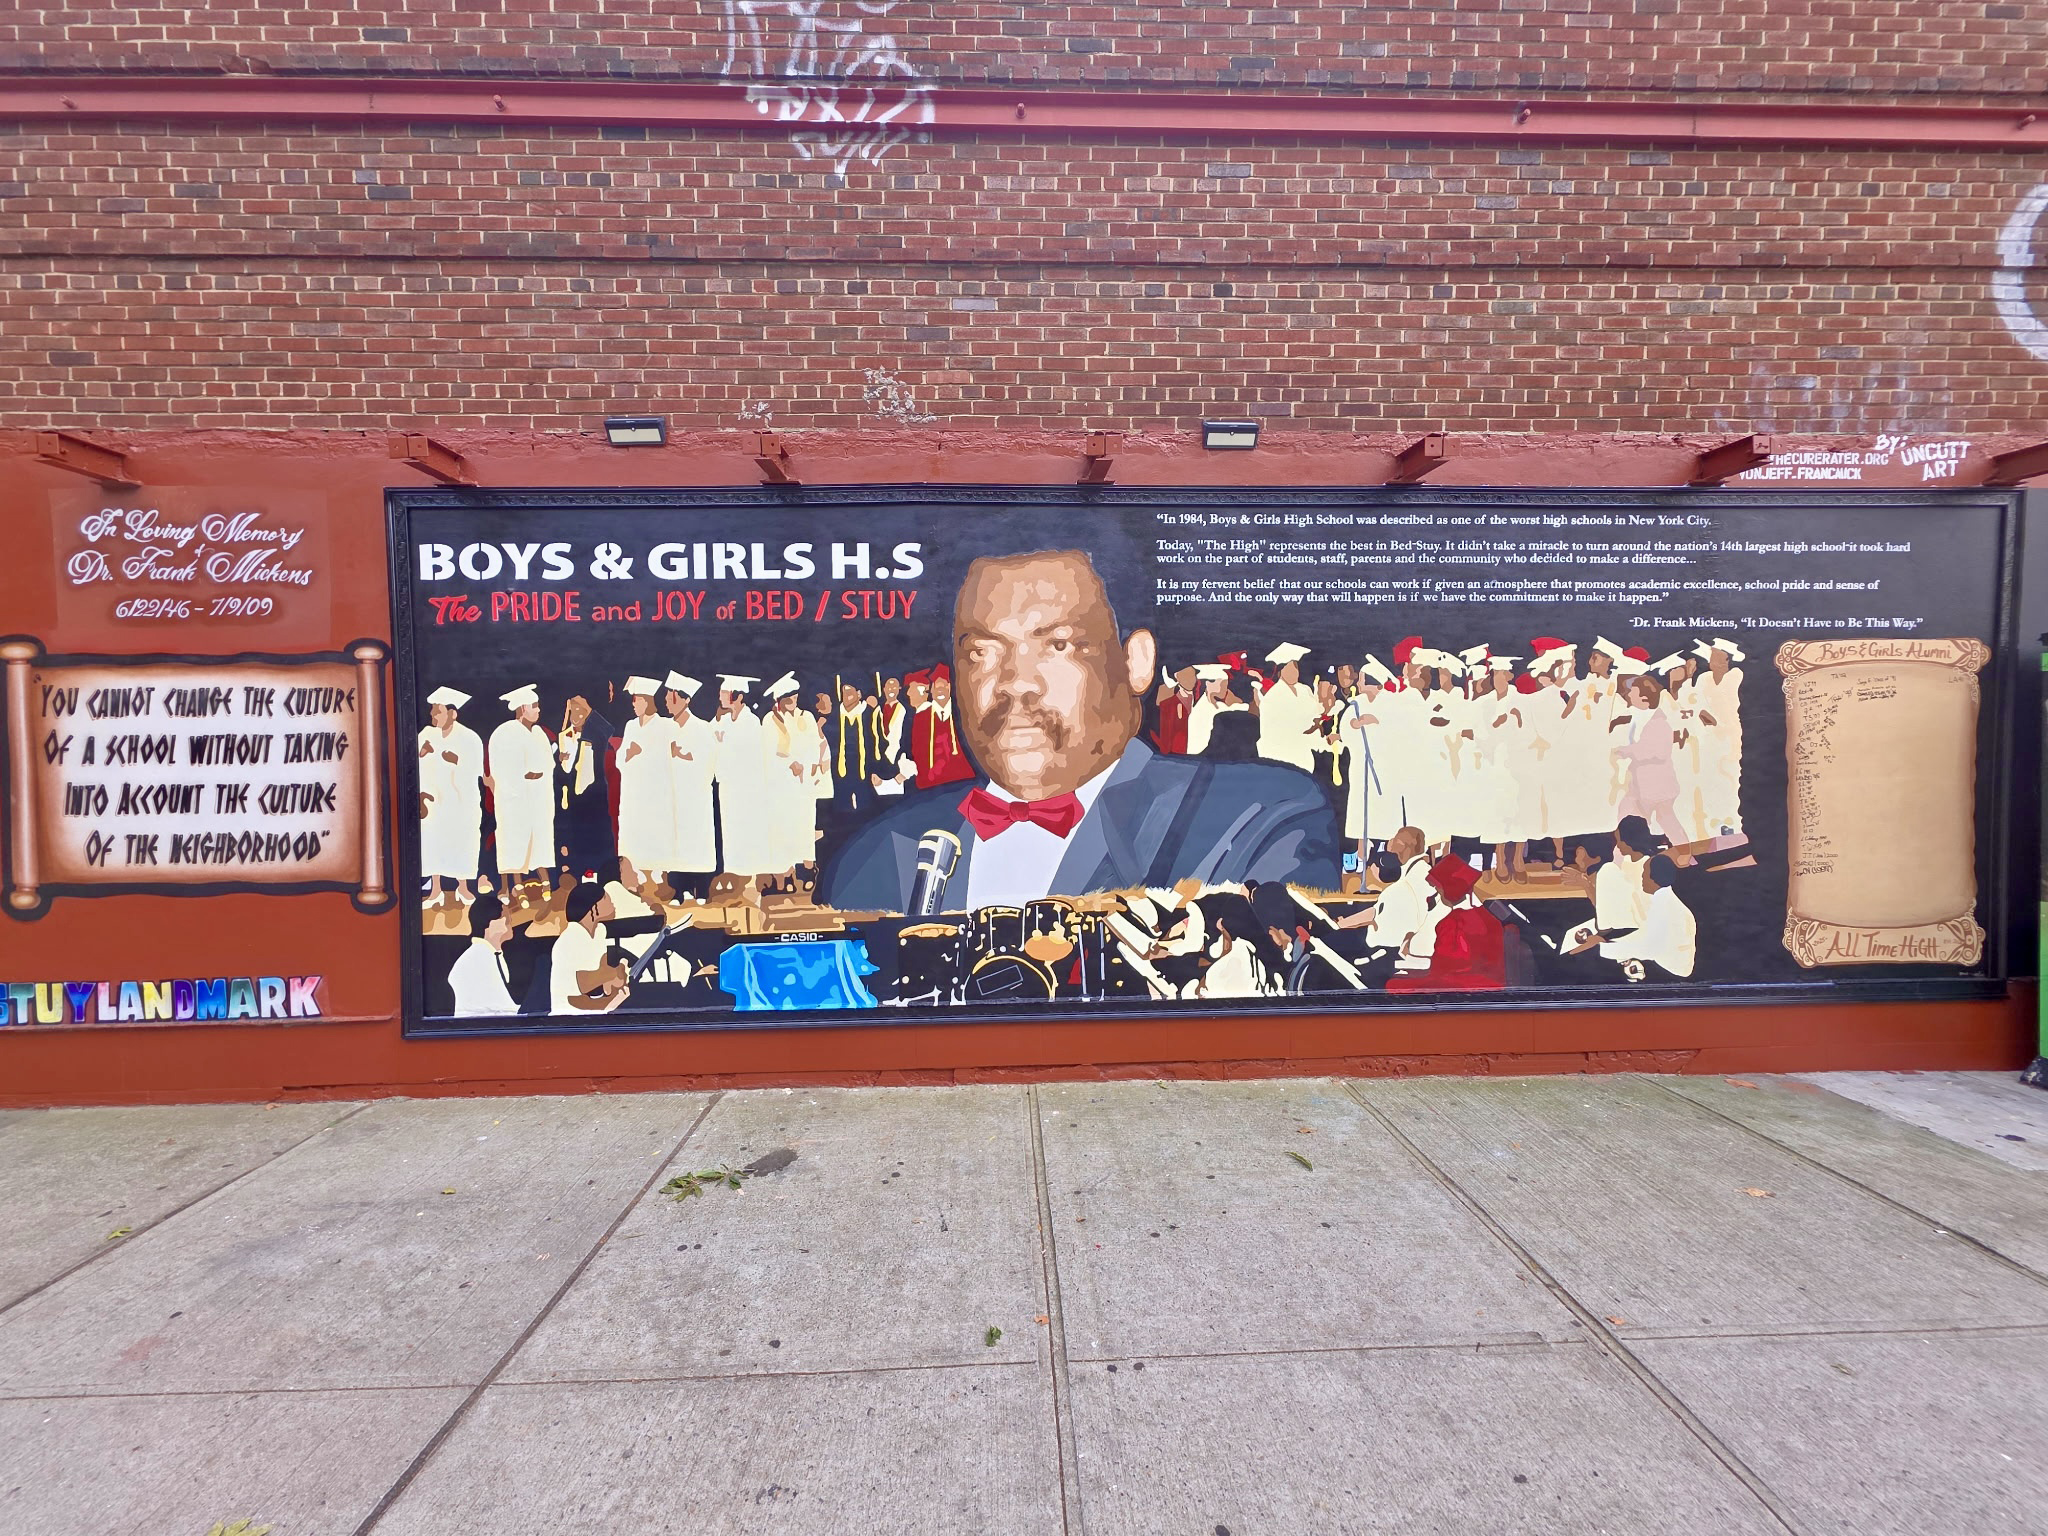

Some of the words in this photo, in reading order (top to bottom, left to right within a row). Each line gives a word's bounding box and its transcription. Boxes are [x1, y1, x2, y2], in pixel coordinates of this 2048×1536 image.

[1901, 441, 1971, 466] UNCUTT
[1922, 459, 1959, 481] ART
[80, 509, 123, 542] In
[124, 509, 198, 548] Loving
[202, 513, 304, 550] Memory
[1178, 513, 1207, 527] 1984,
[1209, 513, 1238, 528] Boys
[1239, 514, 1251, 525] &
[1253, 513, 1282, 525] Girls
[1283, 513, 1314, 528] High
[1316, 513, 1354, 525] School
[1355, 516, 1378, 525] was
[1379, 513, 1434, 525] described
[1436, 517, 1449, 525] as
[1450, 517, 1472, 525] one
[1473, 513, 1487, 525] of
[1489, 514, 1508, 525] the
[1509, 516, 1541, 525] worst
[1542, 514, 1569, 528] high
[1570, 514, 1613, 526] schools
[1614, 514, 1627, 526] in
[1628, 514, 1656, 526] New
[1657, 514, 1685, 526] York
[1686, 514, 1712, 529] City.
[1155, 539, 1194, 554] Today,
[1269, 542, 1327, 554] represents
[1329, 539, 1348, 551] the
[1349, 540, 1374, 551] best
[1445, 540, 1456, 551] It
[1492, 540, 1517, 551] take
[1528, 540, 1569, 551] miracle
[1571, 542, 1584, 551] to
[1585, 542, 1610, 551] turn
[1611, 540, 1652, 551] around
[1653, 540, 1672, 551] the
[1720, 540, 1743, 552] 14th
[1744, 540, 1782, 555] largest
[1783, 541, 1809, 555] high
[1859, 541, 1884, 552] took
[1885, 541, 1911, 552] hard
[1156, 552, 1185, 564] work
[1187, 555, 1202, 563] on
[1204, 552, 1223, 564] the
[1224, 554, 1249, 567] part
[1250, 552, 1265, 564] of
[1266, 552, 1318, 566] students,
[1320, 552, 1349, 566] staff,
[1350, 554, 1392, 567] parents
[1394, 552, 1416, 564] and
[1418, 552, 1437, 564] the
[1438, 552, 1502, 567] community
[1503, 552, 1528, 564] who
[1529, 552, 1574, 564] decided
[1575, 555, 1588, 564] to
[1589, 553, 1620, 564] make
[1631, 553, 1697, 564] difference...
[68, 550, 113, 584] Dr.
[123, 546, 198, 581] Frank
[206, 549, 312, 585] Mickens
[418, 542, 575, 580] BOYS
[589, 542, 634, 580] &
[647, 542, 815, 580] GIRLS
[831, 542, 924, 580] H.S
[1181, 581, 1200, 592] my
[1201, 578, 1241, 589] fervent
[1243, 578, 1276, 590] belief
[1278, 578, 1302, 590] that
[1303, 581, 1324, 589] our
[1325, 578, 1367, 589] schools
[1369, 581, 1390, 589] can
[1391, 578, 1420, 589] work
[1421, 578, 1432, 589] if
[1434, 578, 1465, 592] given
[1466, 581, 1482, 590] an
[1483, 578, 1548, 593] atmosphere
[1550, 578, 1573, 589] that
[1574, 580, 1626, 592] promotes
[1628, 578, 1681, 590] academic
[1682, 579, 1743, 592] excellence,
[1744, 579, 1780, 590] school
[1781, 579, 1811, 593] pride
[1812, 579, 1834, 590] and
[1835, 582, 1866, 590] sense
[1867, 579, 1881, 590] of
[209, 597, 273, 617] 7/9/09
[428, 594, 482, 624] The
[492, 590, 581, 622] PRIDE
[592, 601, 642, 622] and
[651, 590, 705, 622] JOY
[715, 599, 736, 621] of
[745, 589, 803, 621] BED
[841, 590, 917, 621] STUY
[1155, 594, 1206, 606] purpose.
[1207, 591, 1233, 602] And
[1234, 591, 1253, 602] the
[1254, 591, 1280, 606] only
[1281, 594, 1305, 605] way
[1306, 591, 1329, 602] that
[1330, 591, 1352, 602] will
[1353, 591, 1396, 605] happen
[1409, 591, 1420, 602] if
[1422, 594, 1439, 602] we
[1440, 591, 1467, 602] have
[1468, 591, 1487, 602] the
[1488, 591, 1560, 602] commitment
[1575, 591, 1606, 602] make
[1653, 616, 1687, 628] Frank
[1688, 616, 1738, 630] Mickens,
[1803, 617, 1832, 628] Have
[1864, 617, 1890, 628] This
[86, 687, 155, 719] CANNOT
[163, 687, 233, 718] CHANGE
[244, 687, 275, 717] THE
[284, 687, 355, 717] CULTURE
[44, 729, 73, 766] OF
[82, 735, 95, 766] A
[105, 734, 176, 766] SCHOOL
[190, 734, 273, 766] WITHOUT
[284, 731, 349, 765] TAKING
[64, 782, 109, 816] INTO
[116, 782, 205, 816] ACCOUNT
[215, 783, 250, 815] THE
[258, 782, 337, 815] CULTURE
[85, 830, 115, 867] OF
[125, 831, 159, 866] THE
